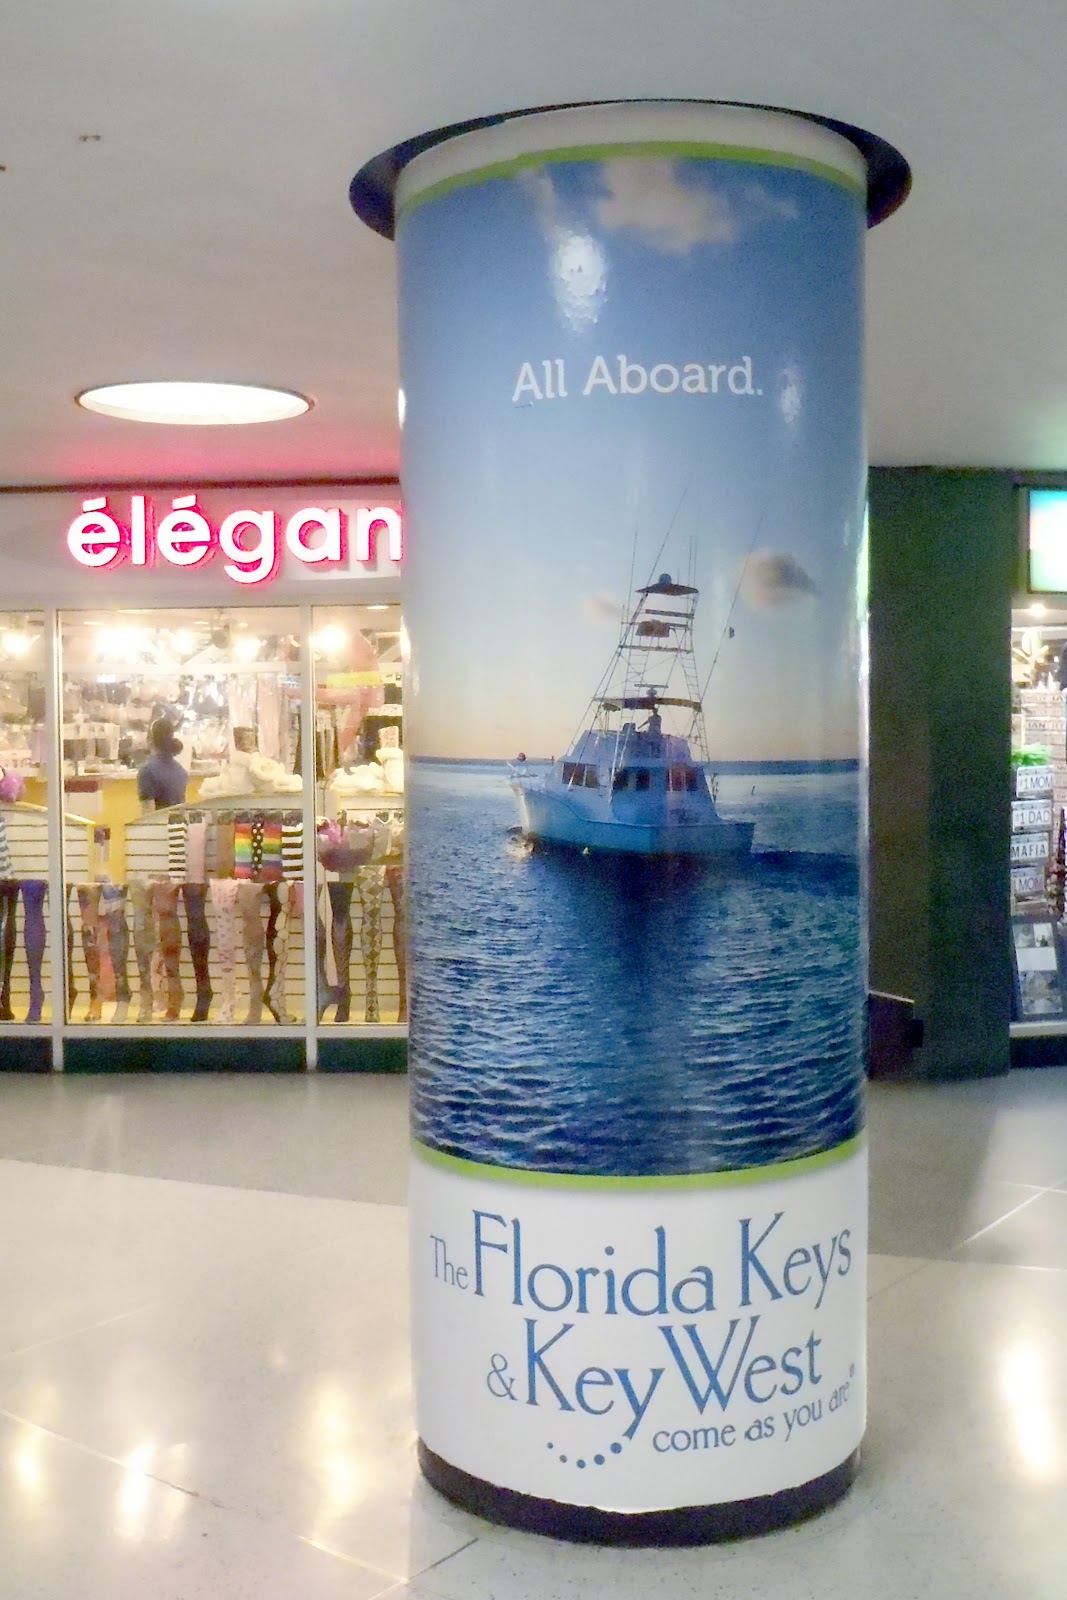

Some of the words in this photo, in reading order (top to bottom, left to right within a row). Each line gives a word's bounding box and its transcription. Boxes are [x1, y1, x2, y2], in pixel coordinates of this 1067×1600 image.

[512, 362, 568, 402] All
[583, 355, 764, 396] Aboard.
[1028, 810, 1051, 824] DAD
[1010, 843, 1046, 858] MAFIA
[430, 1234, 469, 1291] The
[472, 1209, 716, 1317] Florida
[739, 1211, 852, 1310] Keys
[486, 1353, 518, 1401] &
[524, 1318, 666, 1440] Key
[658, 1315, 823, 1415] West
[652, 1423, 737, 1453] come
[744, 1416, 776, 1441] as
[783, 1398, 823, 1442] you
